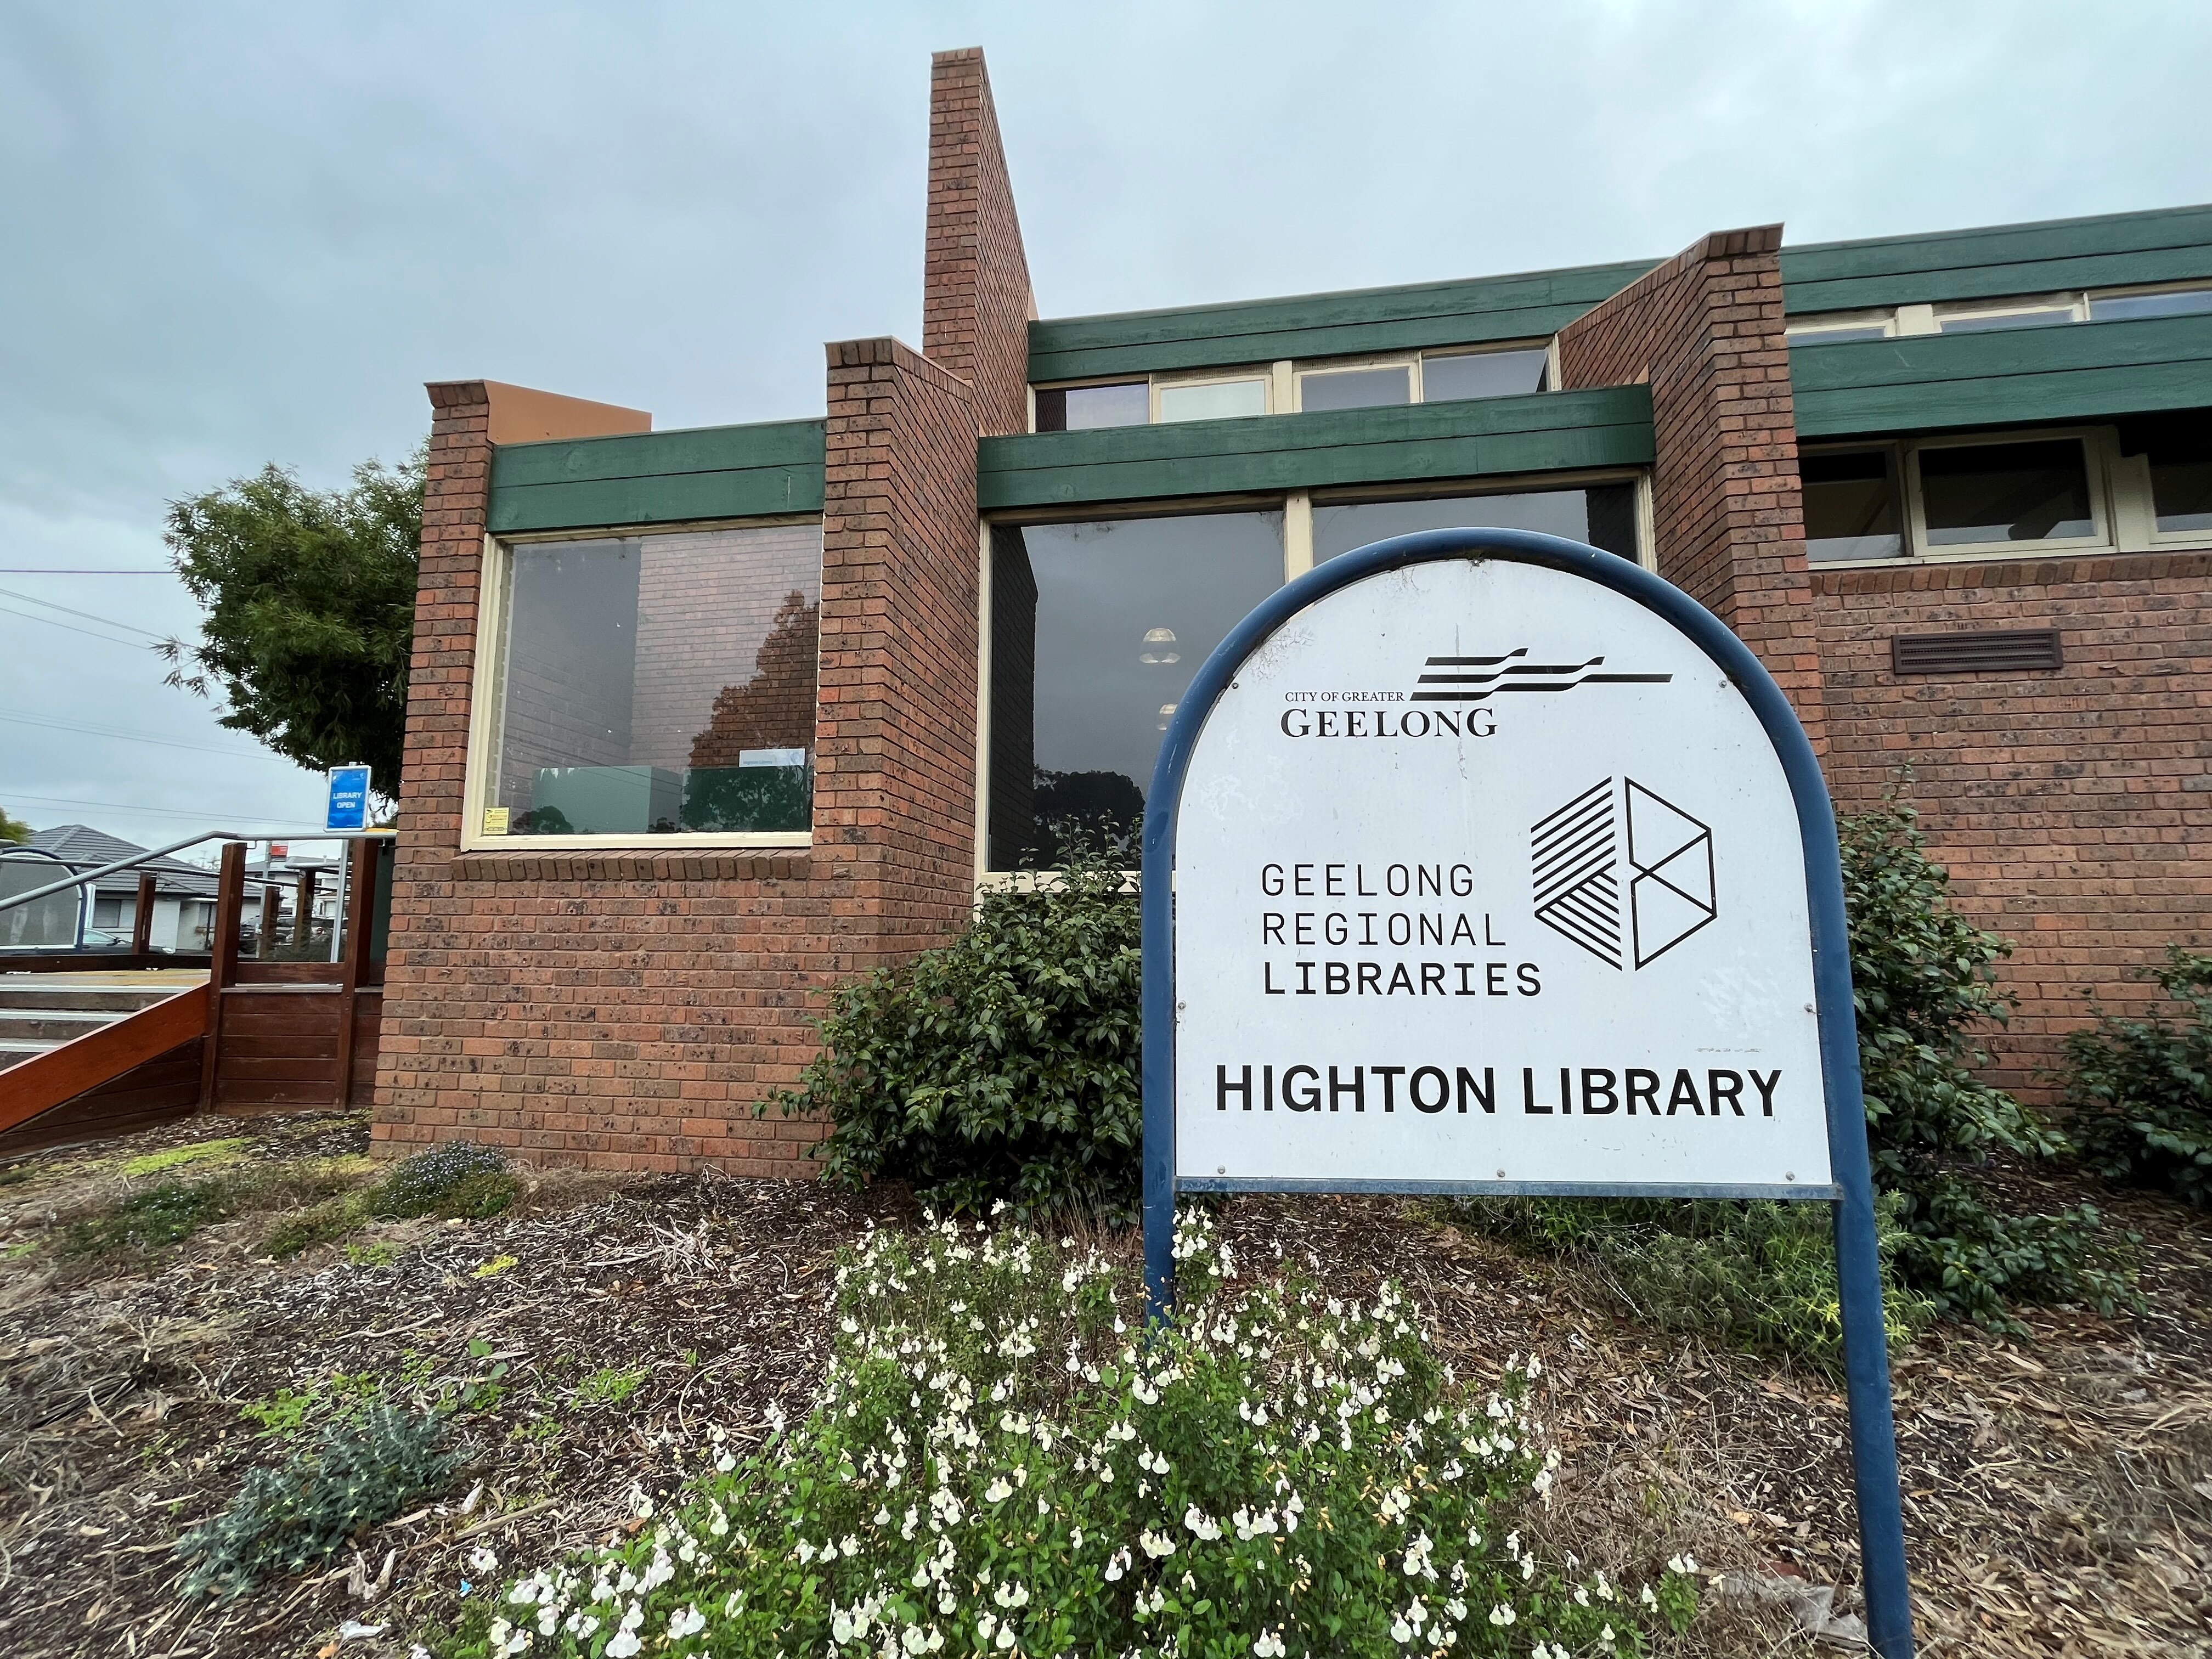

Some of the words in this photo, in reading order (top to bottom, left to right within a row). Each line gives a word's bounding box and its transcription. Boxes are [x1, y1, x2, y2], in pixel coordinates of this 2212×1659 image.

[1285, 692, 1317, 702] CITY
[1321, 692, 1339, 702] OF
[1342, 692, 1405, 702] GREATER
[1281, 708, 1498, 737] GEELONG
[1262, 864, 1473, 897] GEELONG
[1263, 912, 1506, 946] REGIONAL
[1265, 962, 1541, 996] LIBRARIES
[1217, 1064, 1496, 1114] HIGHTON
[1523, 1067, 1782, 1117] LIBRARY
